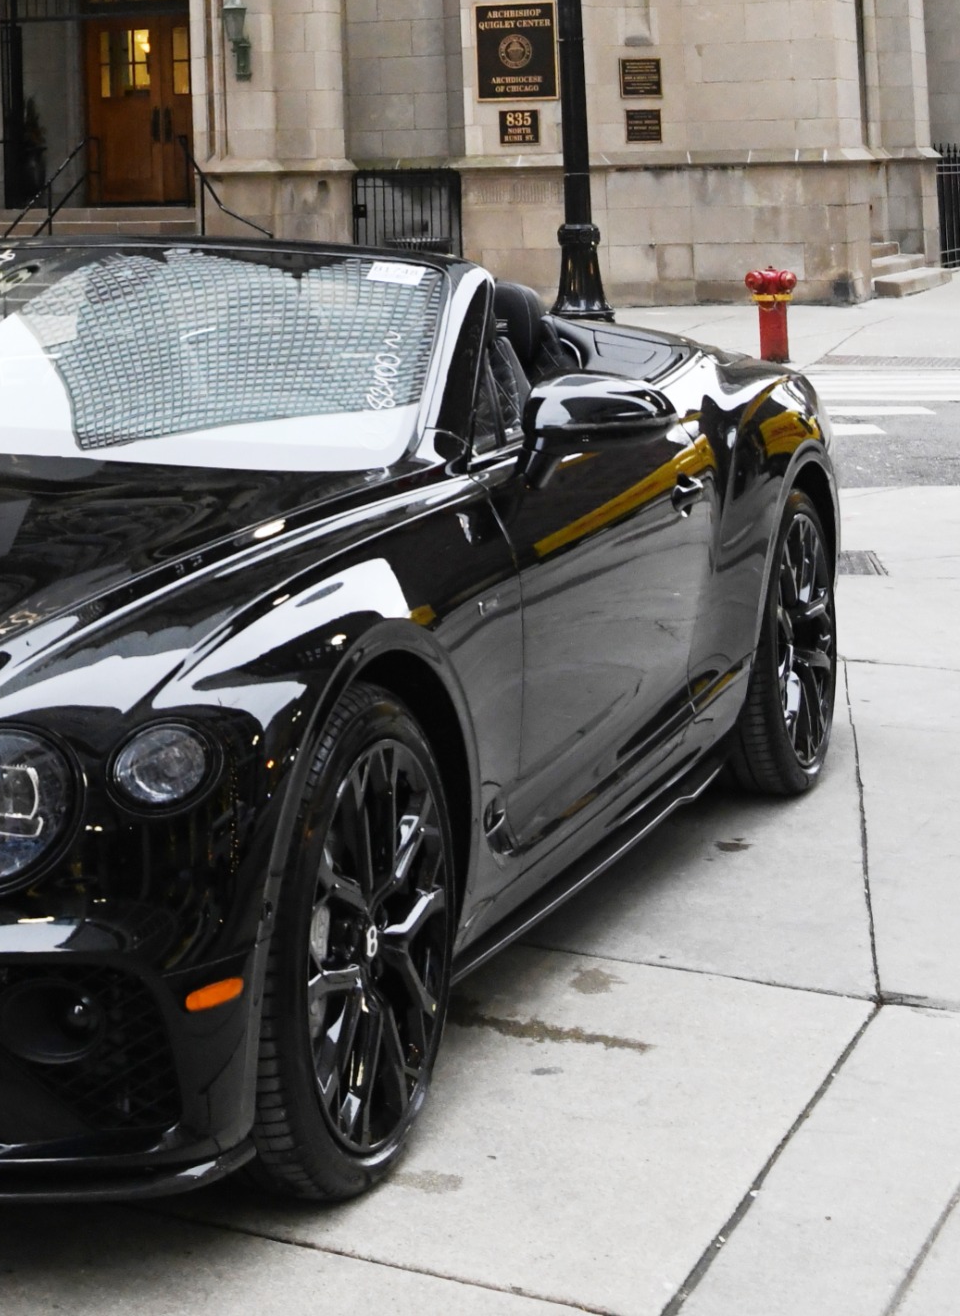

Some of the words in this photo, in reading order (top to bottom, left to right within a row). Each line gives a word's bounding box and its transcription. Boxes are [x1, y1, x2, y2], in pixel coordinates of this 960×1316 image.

[486, 8, 542, 19] ARCHBISHOP
[478, 20, 516, 30] QUIGLEY
[516, 19, 551, 28] CENTER
[491, 76, 543, 84] ARCHDIOCESE
[506, 85, 539, 93] CHICAGO
[506, 112, 532, 127] 835
[507, 127, 531, 135] NORTH
